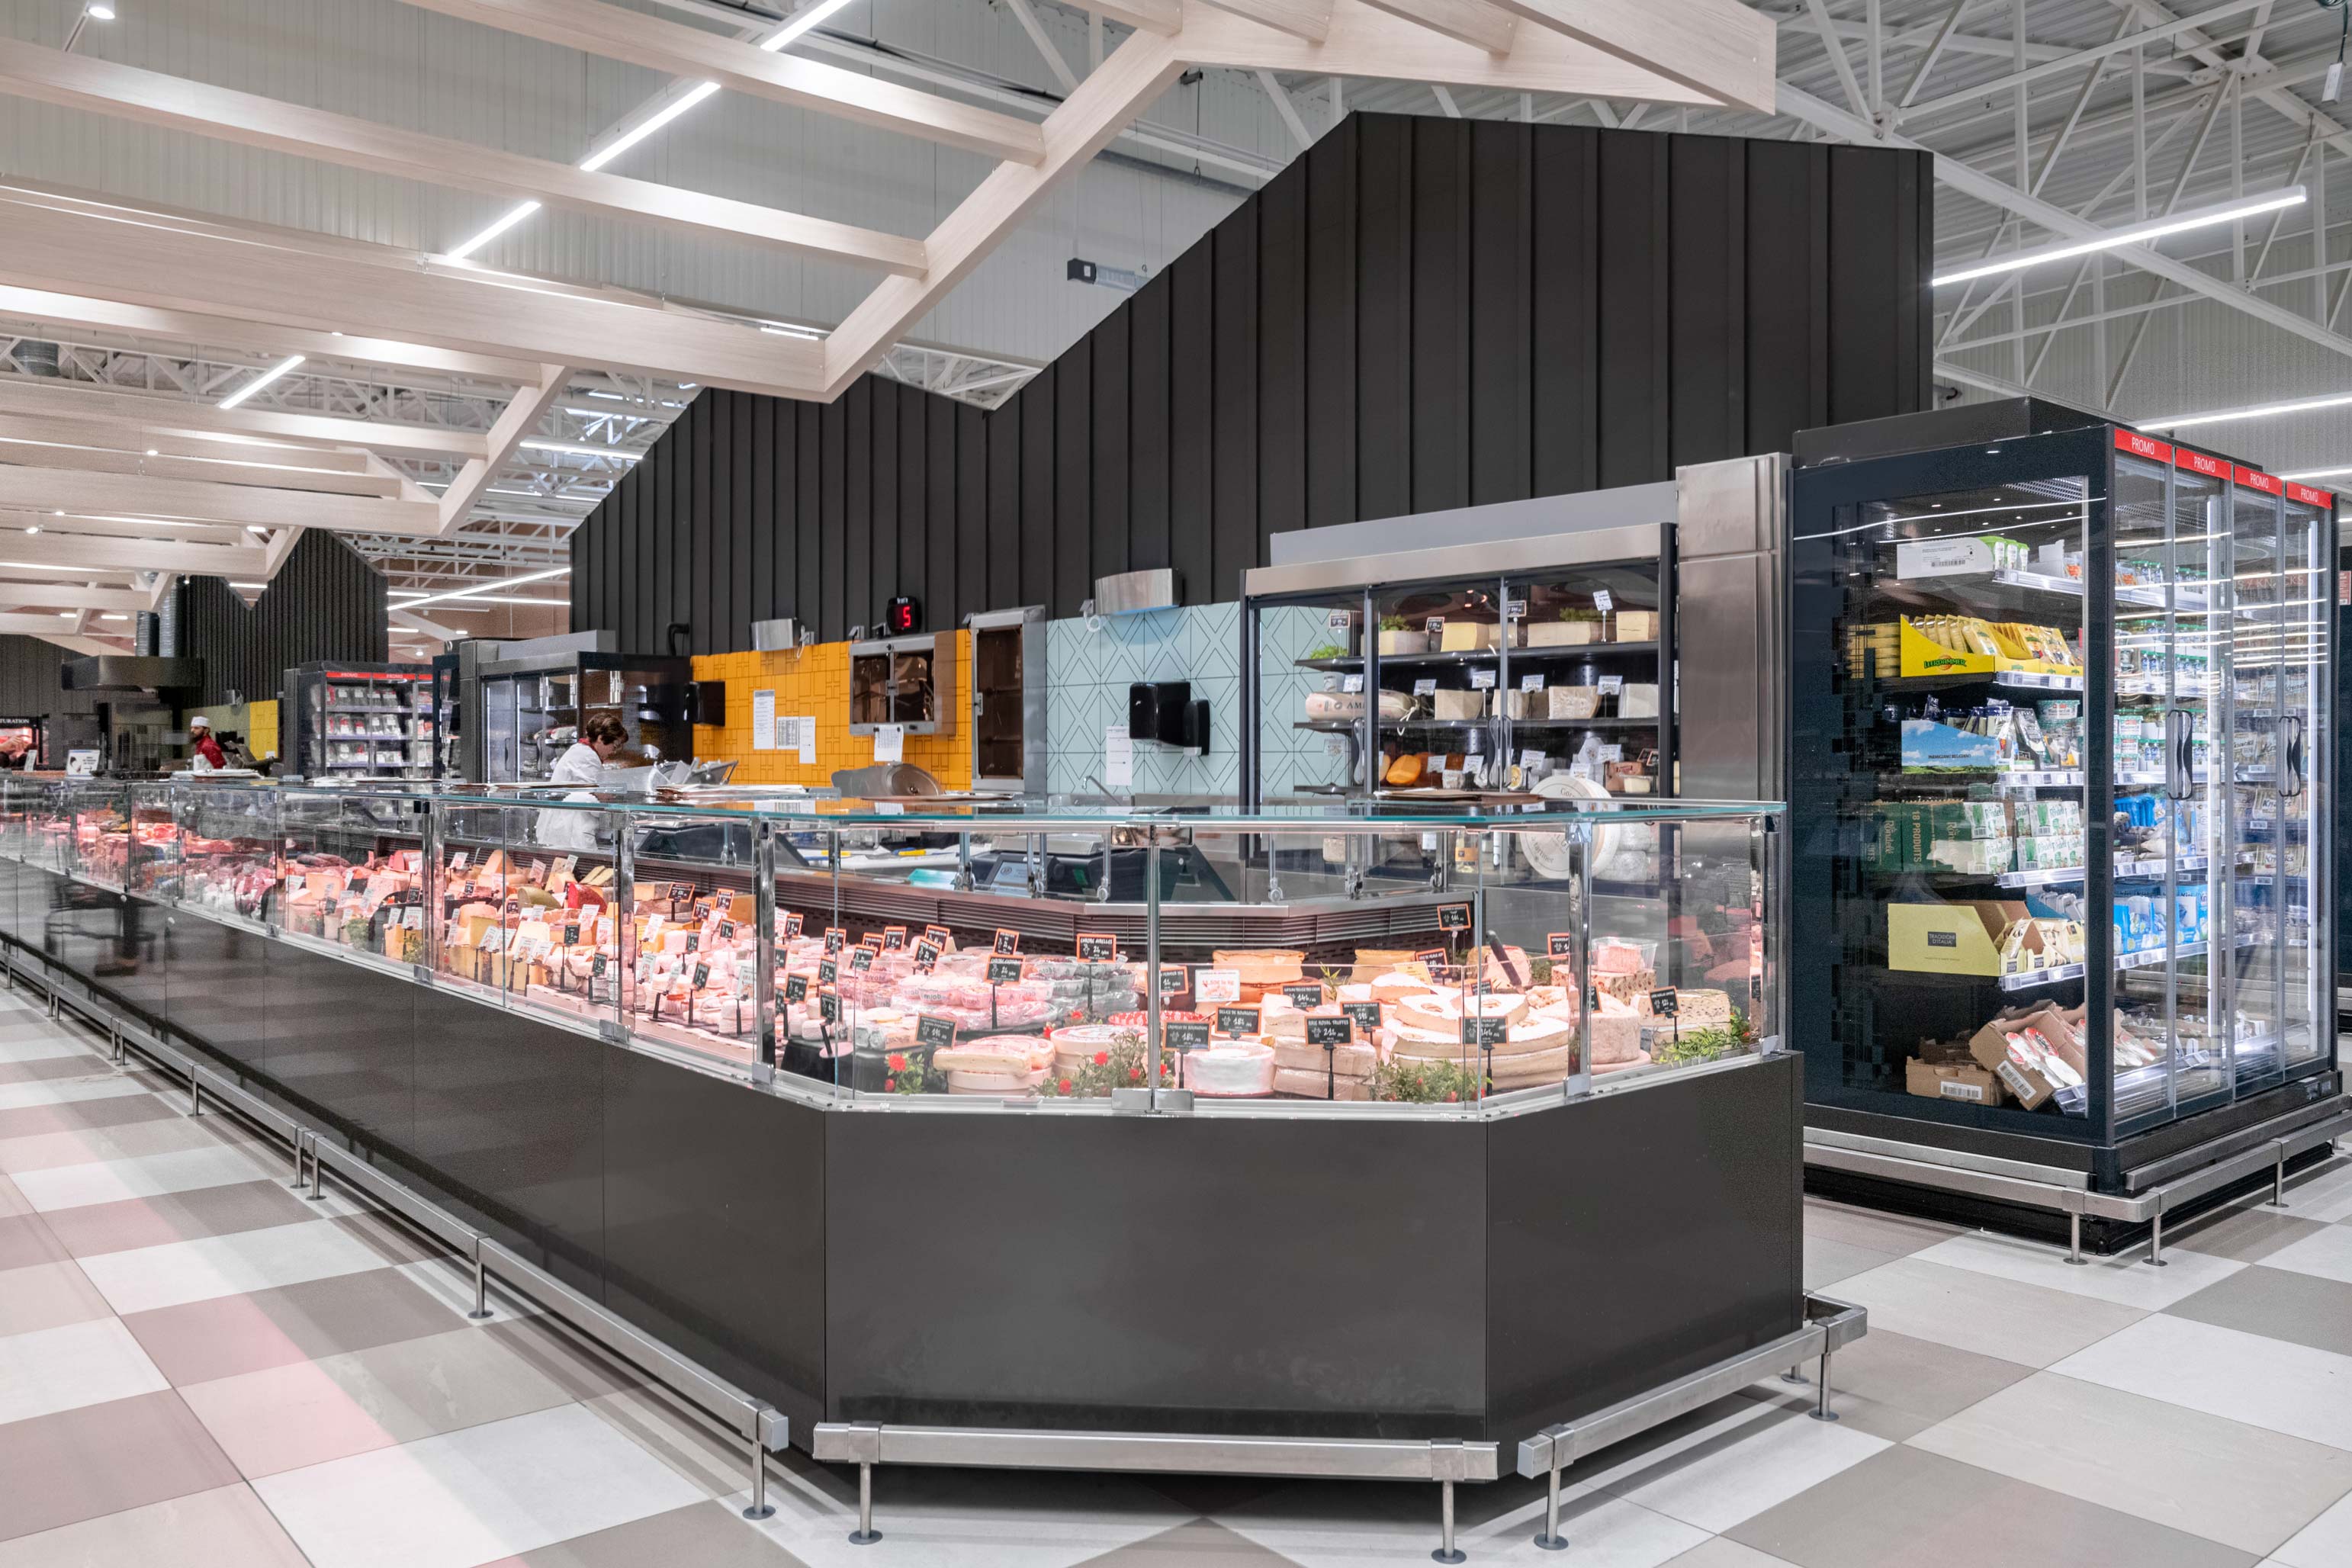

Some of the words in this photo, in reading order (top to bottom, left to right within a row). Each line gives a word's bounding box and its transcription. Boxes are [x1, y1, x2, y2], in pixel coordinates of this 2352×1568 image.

[2132, 441, 2154, 456] PROMO
[2193, 455, 2215, 472] PROMO
[2250, 472, 2269, 489] PROMO
[2300, 487, 2318, 503] PROMO
[903, 606, 911, 627] 5
[1912, 810, 1920, 821] 18
[1912, 822, 1922, 863] PRODUITS
